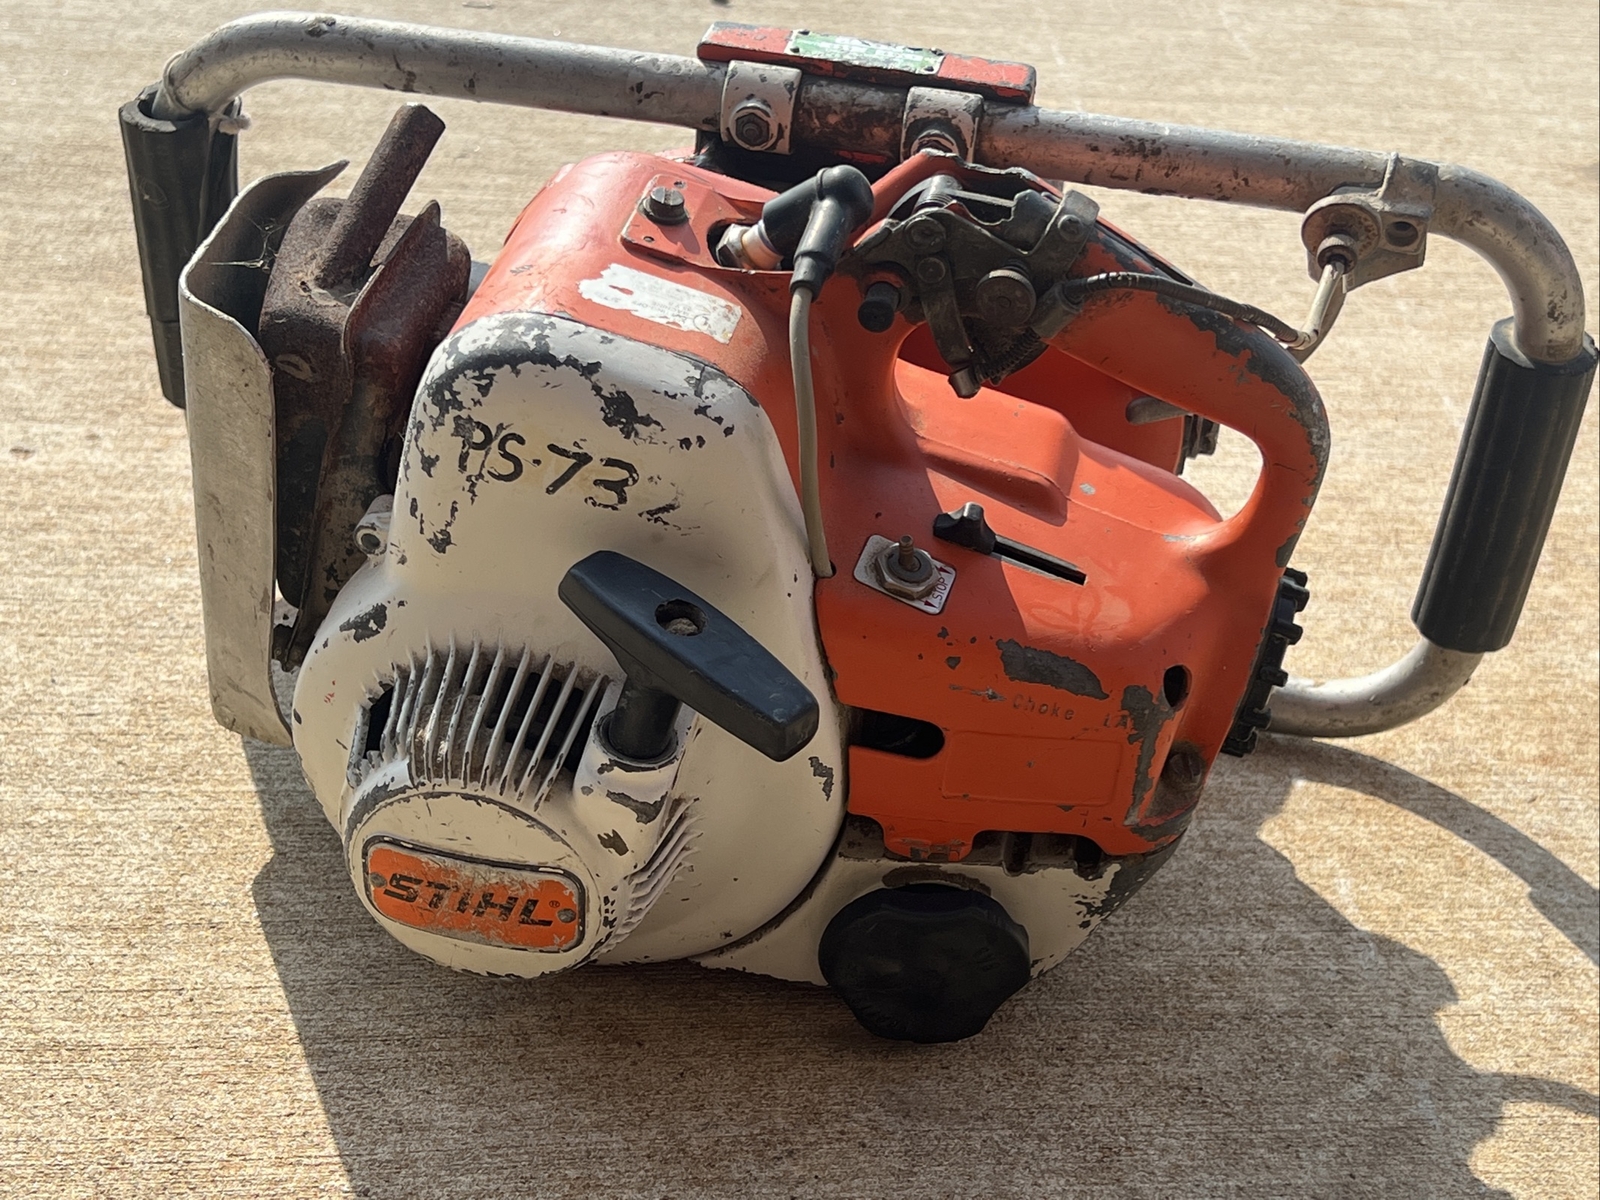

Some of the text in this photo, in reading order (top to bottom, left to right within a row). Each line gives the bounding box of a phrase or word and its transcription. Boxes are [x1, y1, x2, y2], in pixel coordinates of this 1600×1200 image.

[931, 576, 948, 601] STOP
[1012, 694, 1075, 720] Choke
[383, 873, 554, 927] STIHL
